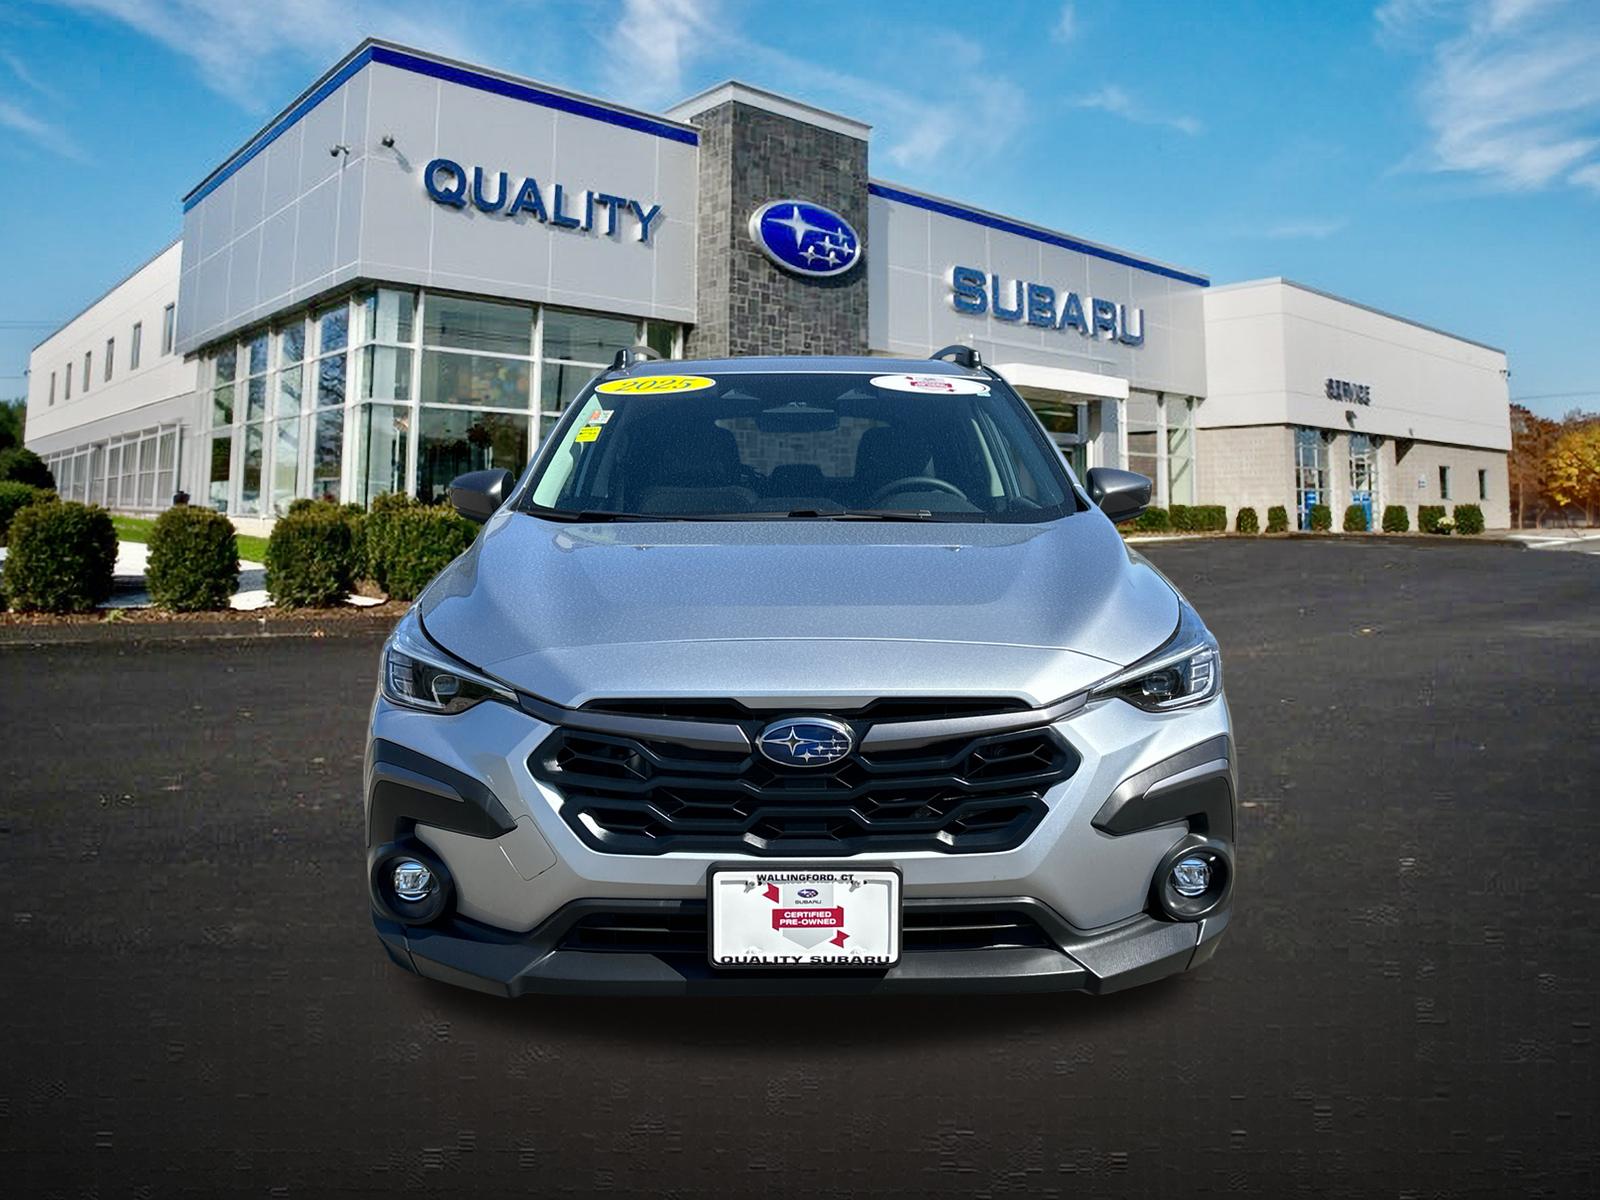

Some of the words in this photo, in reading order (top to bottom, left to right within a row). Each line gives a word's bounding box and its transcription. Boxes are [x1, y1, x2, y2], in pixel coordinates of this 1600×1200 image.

[424, 158, 662, 243] QUALITY
[950, 265, 1145, 347] SUBARU
[615, 379, 694, 392] 2025
[840, 873, 855, 882] CT
[779, 918, 837, 926] PRE-OWNED
[720, 955, 803, 965] QUALITY
[809, 955, 890, 965] SUBARU
